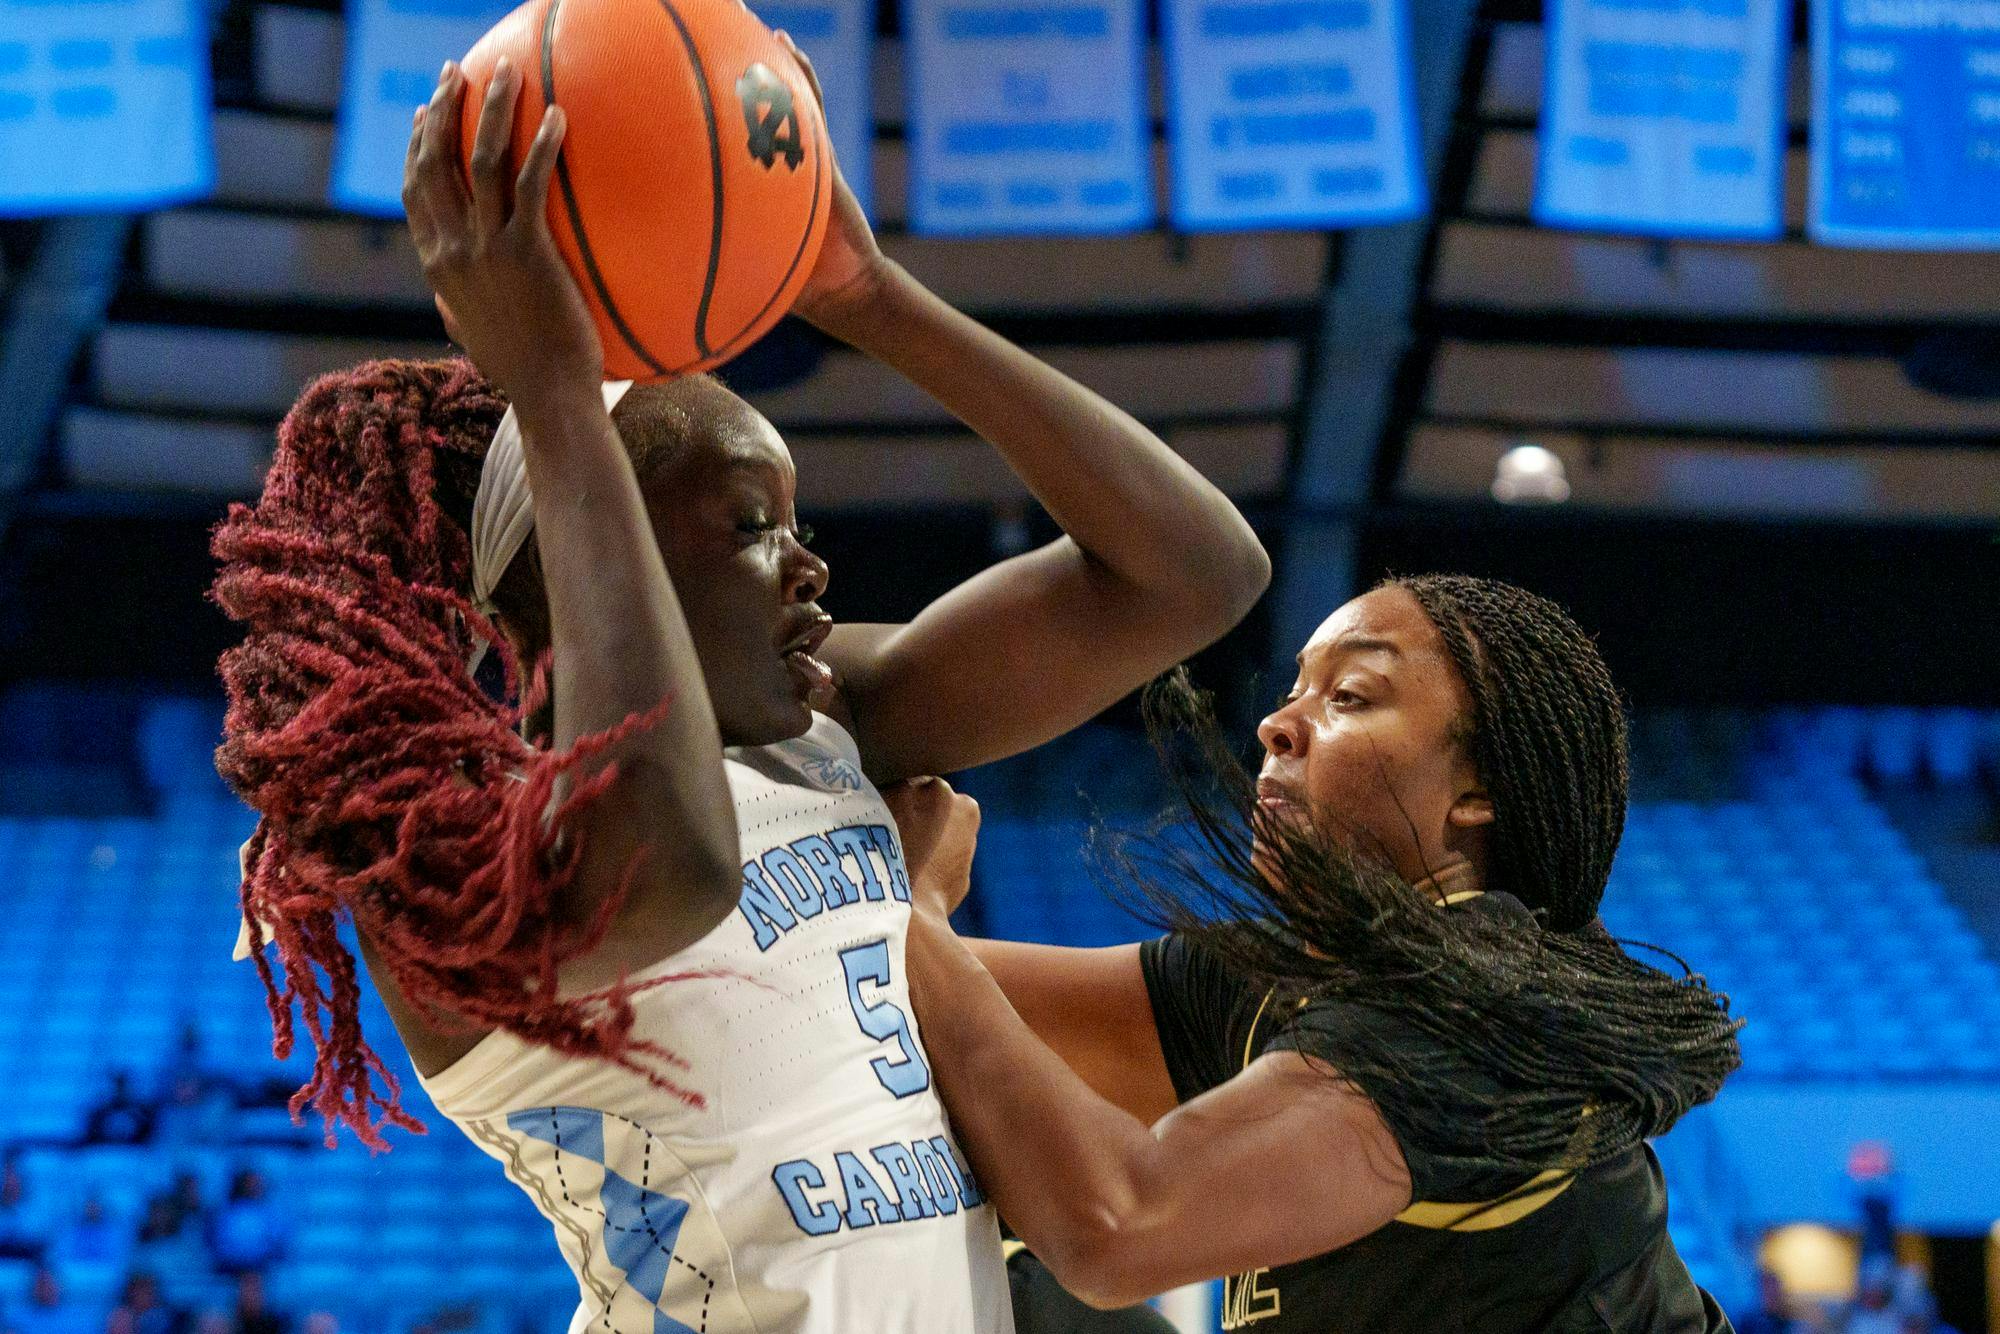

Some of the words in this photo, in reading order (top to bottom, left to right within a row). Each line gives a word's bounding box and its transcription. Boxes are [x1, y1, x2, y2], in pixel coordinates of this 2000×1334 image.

[738, 824, 912, 953] NORTH
[837, 938, 930, 1101] 5
[771, 1134, 987, 1237] CAROL
